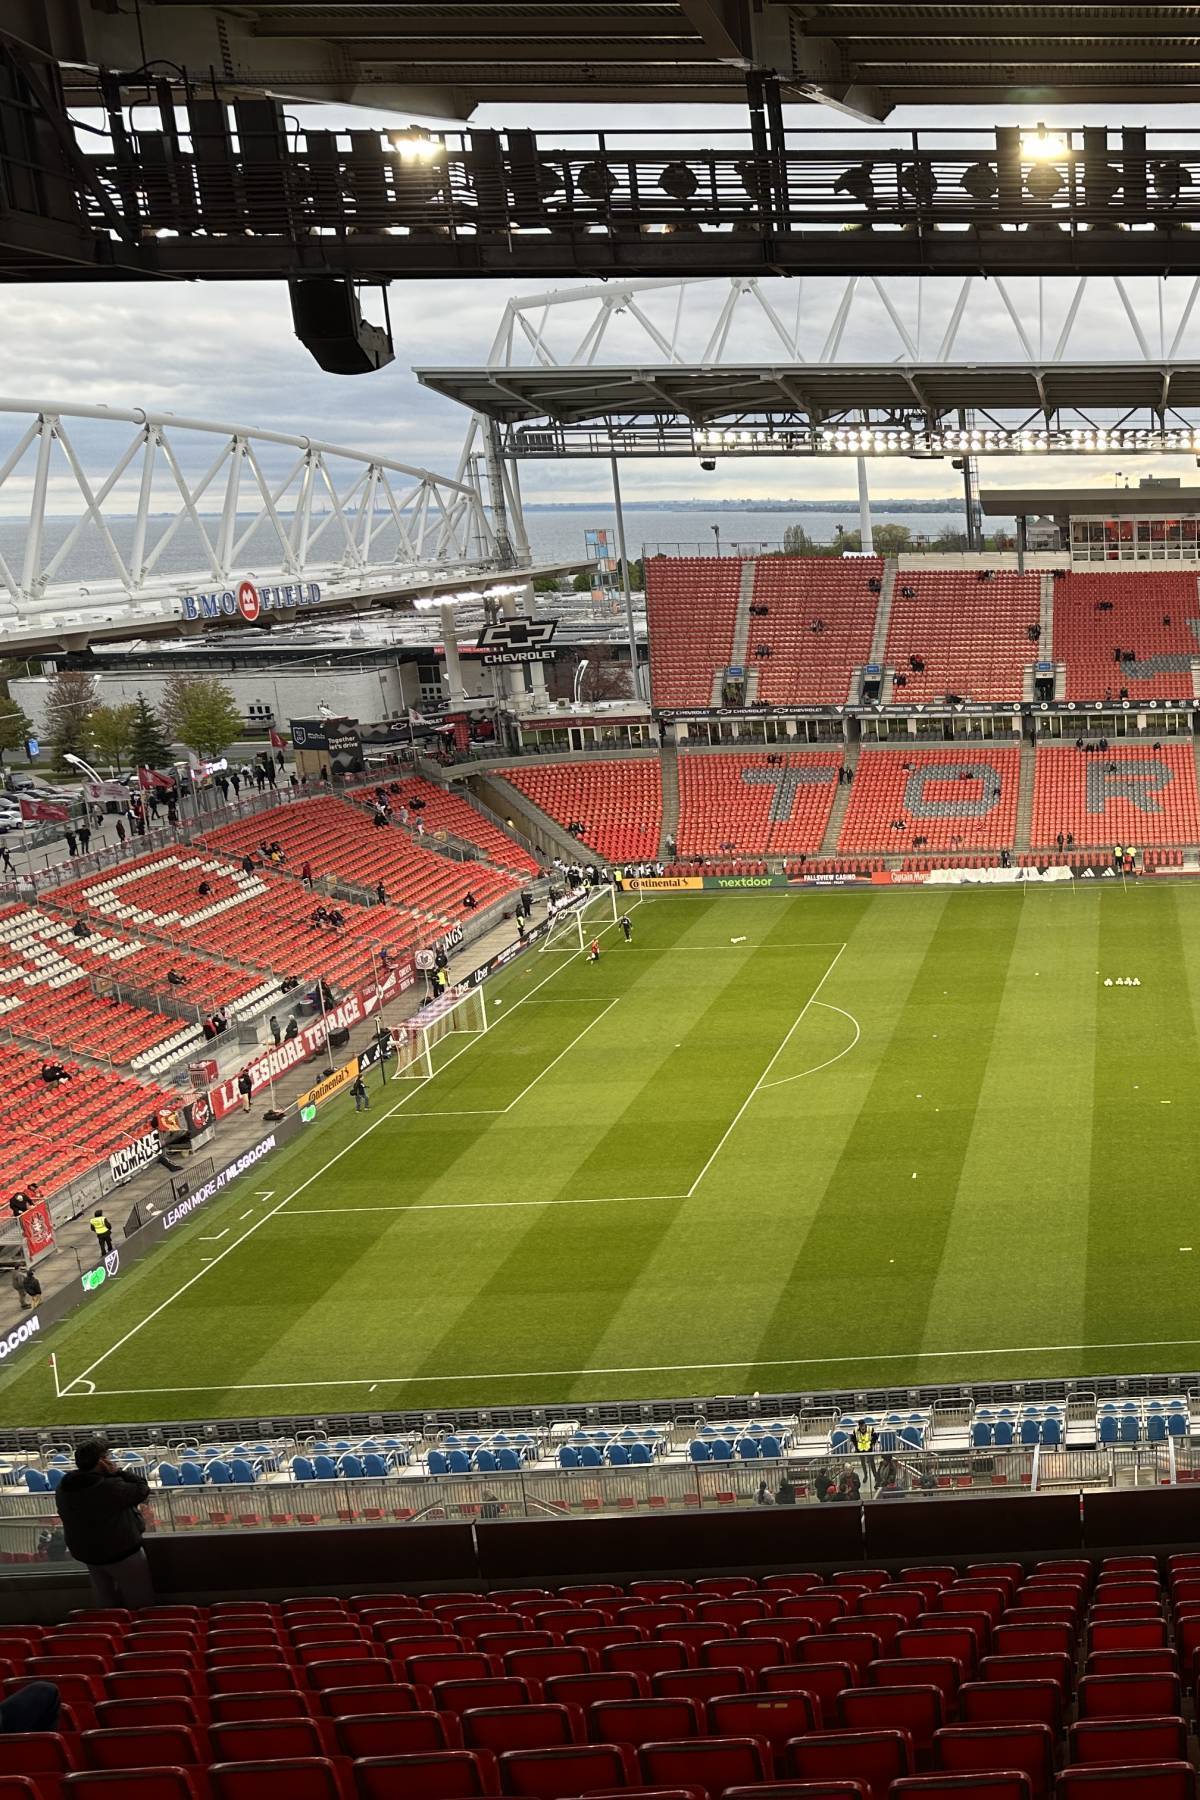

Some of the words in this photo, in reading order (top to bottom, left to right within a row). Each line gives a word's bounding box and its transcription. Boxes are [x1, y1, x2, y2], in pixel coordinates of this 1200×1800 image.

[184, 591, 236, 620] BMO
[260, 583, 321, 610] FIELD
[484, 650, 557, 663] CHEVROLET
[328, 736, 356, 745] Together
[342, 741, 358, 749] drive
[629, 878, 680, 889] Continental
[718, 877, 773, 887] nextdoor
[891, 871, 913, 883] Captain
[474, 966, 488, 984] Uber
[455, 980, 470, 997] Uber
[221, 1036, 306, 1110] LAESHORE
[308, 1069, 346, 1101] Continental
[163, 1198, 192, 1230] LEARN
[190, 1180, 217, 1208] MORE
[216, 1172, 227, 1189] AT
[226, 1134, 276, 1182] MLSGO.COM
